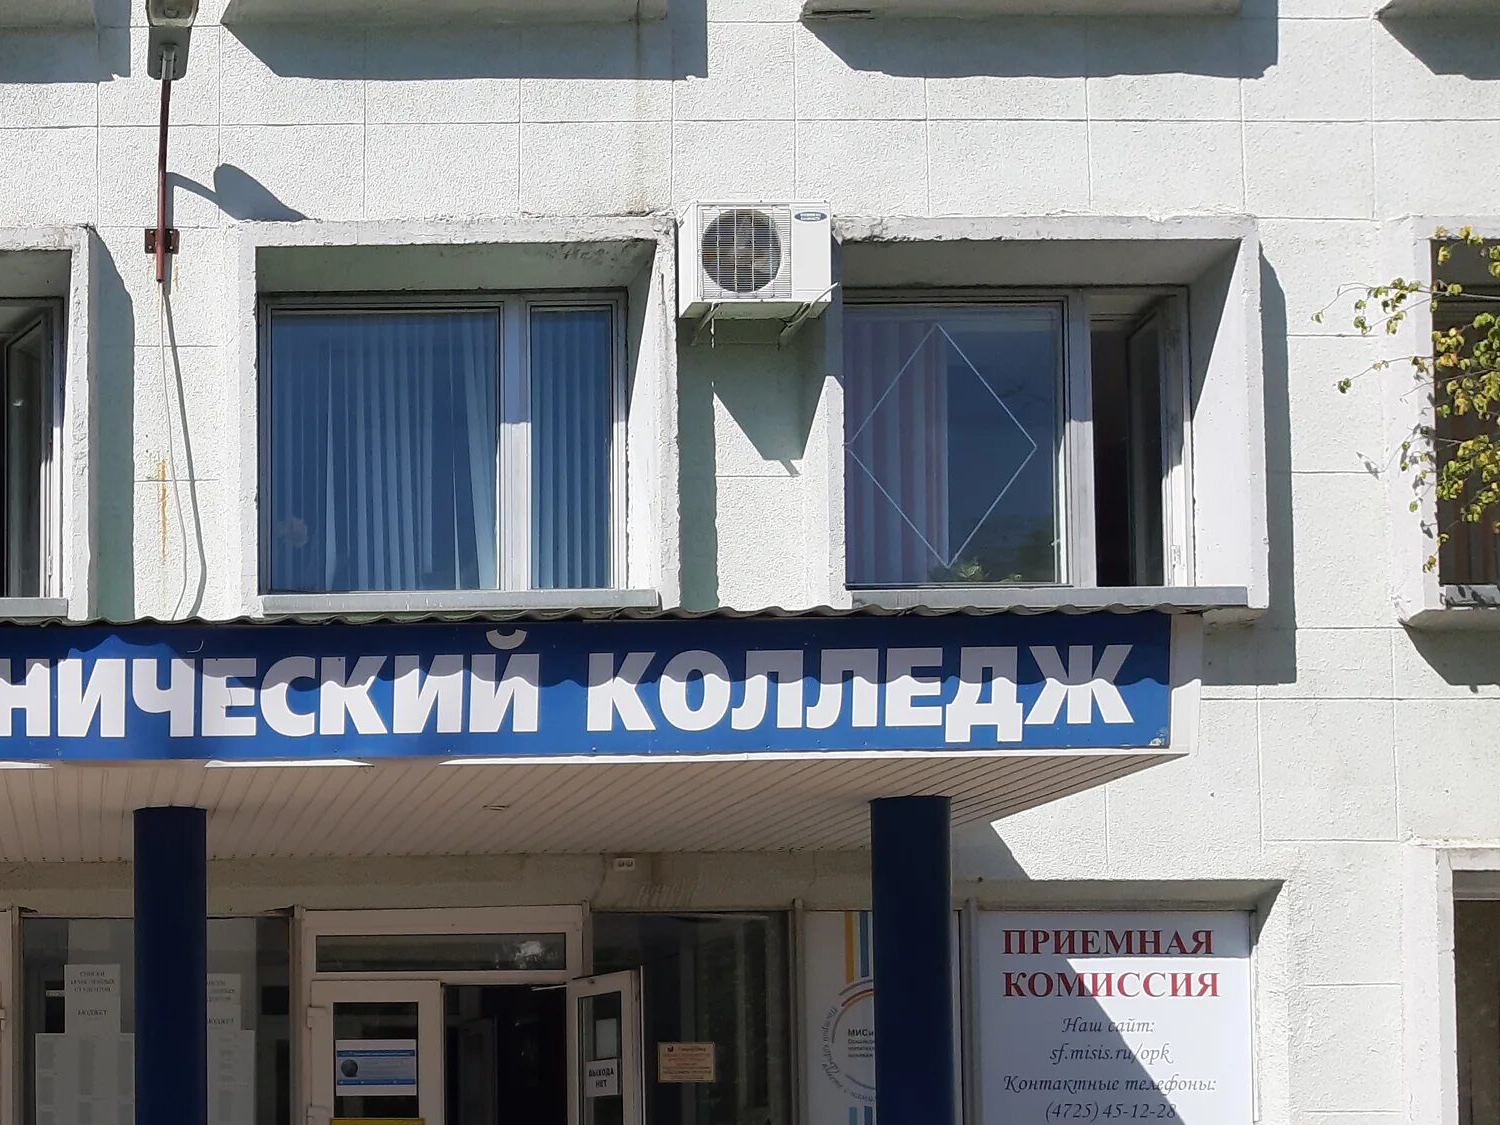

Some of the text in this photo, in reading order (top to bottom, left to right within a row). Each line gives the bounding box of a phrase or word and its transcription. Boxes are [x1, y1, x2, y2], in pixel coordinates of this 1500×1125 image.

[586, 644, 1134, 743] КОЛЛЕДЖ
[1002, 929, 1215, 955] ПРИЕМНАЯ
[1002, 971, 1220, 998] КОМИССИЯ
[848, 1028, 874, 1037] МИСи
[1061, 1017, 1155, 1033] Наш сайт:
[1049, 1042, 1174, 1065] sf.misis.ru/opk
[1003, 1074, 1217, 1096] Контактные телефоны:
[1045, 1102, 1176, 1122] (4725) 45-12-28
